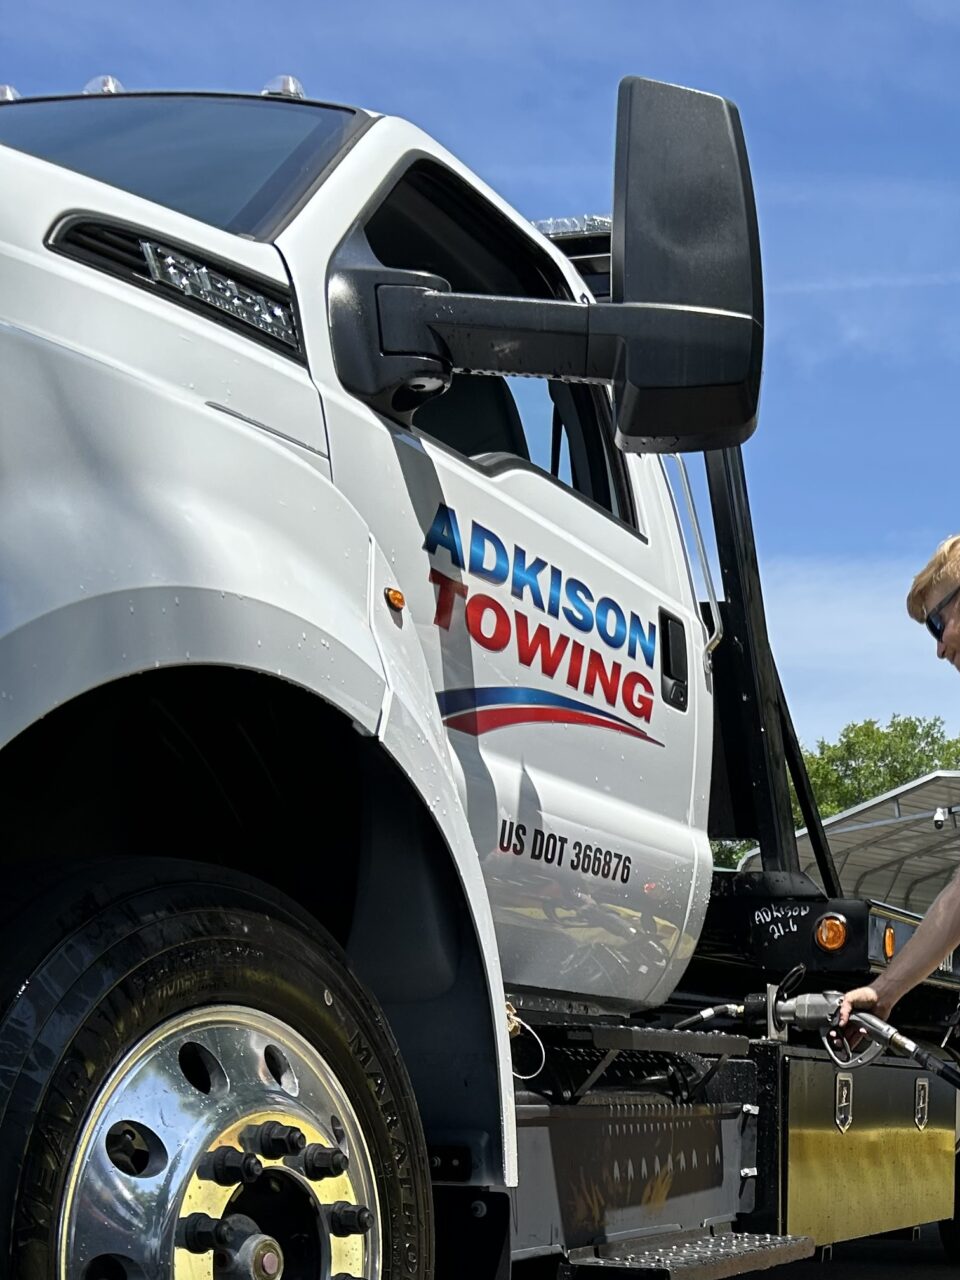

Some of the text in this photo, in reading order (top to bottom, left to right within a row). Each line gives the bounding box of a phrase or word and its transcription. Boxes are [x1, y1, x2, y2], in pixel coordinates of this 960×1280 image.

[422, 503, 656, 669] ADKISON
[428, 567, 655, 724] TOWING
[499, 819, 632, 884] US DOT 366876
